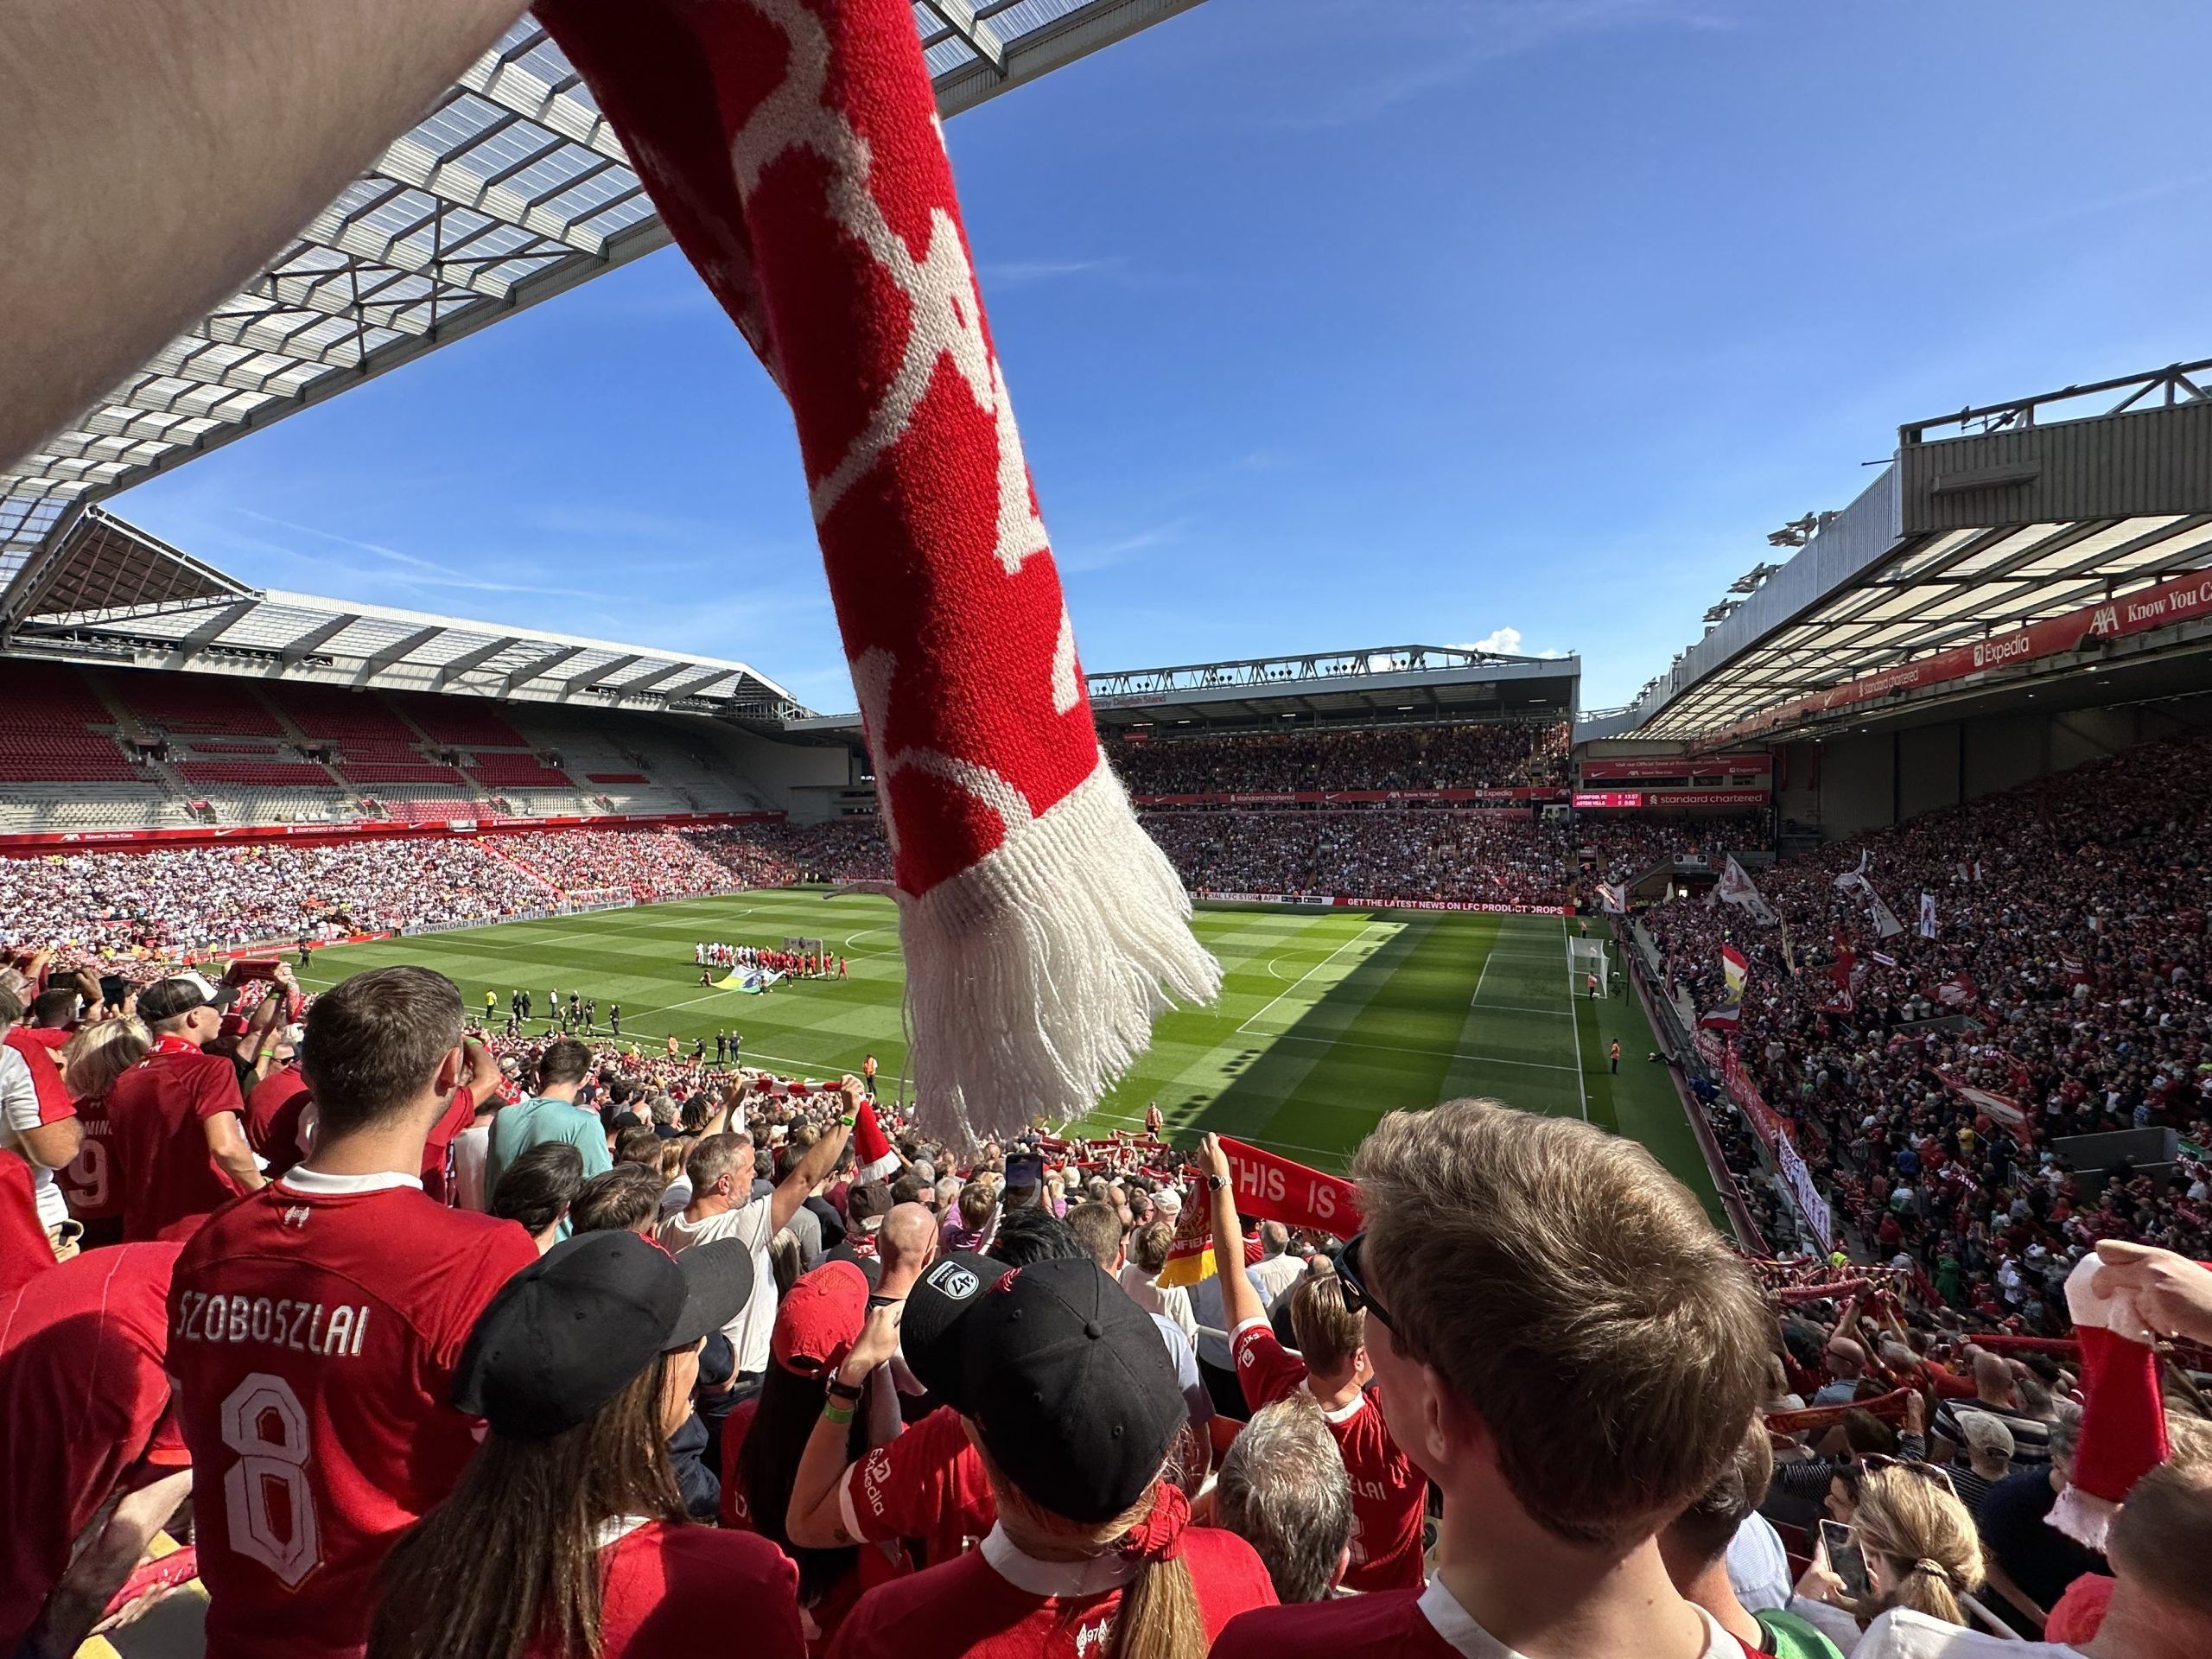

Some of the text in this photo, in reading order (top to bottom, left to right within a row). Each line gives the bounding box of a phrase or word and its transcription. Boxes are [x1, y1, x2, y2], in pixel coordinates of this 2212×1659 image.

[2088, 582, 2212, 635] AXA Know You C
[1985, 634, 2029, 664] Expedia
[1864, 669, 1919, 696] standard chartered
[1661, 794, 1762, 804] standard chartered
[1384, 899, 1417, 908] LATEST
[1419, 901, 1445, 910] NEWS
[1482, 904, 1527, 913] PRODUCT
[416, 920, 468, 934] DOWNLOAD
[471, 918, 488, 927] THE
[493, 914, 525, 925] FFICIAL
[528, 911, 543, 919] LFC
[85, 1120, 114, 1135] MIN
[68, 1139, 108, 1207] 9
[1228, 1156, 1336, 1218] THIS IS
[1170, 1233, 1213, 1252] NFIELD
[175, 1290, 371, 1356] SZOBOSZLAI
[220, 1372, 325, 1593] 8
[1087, 1627, 1099, 1643] 97
